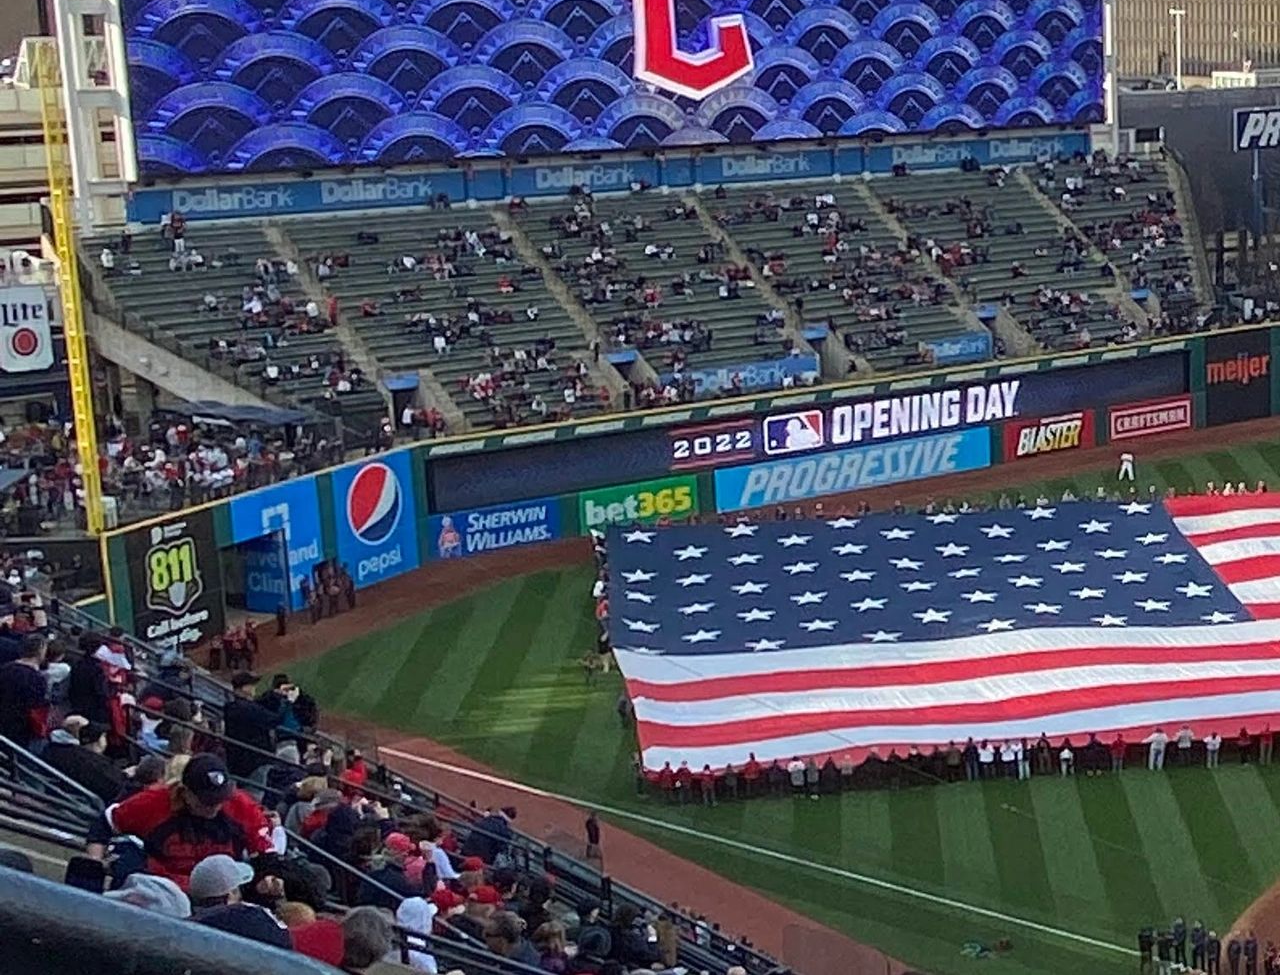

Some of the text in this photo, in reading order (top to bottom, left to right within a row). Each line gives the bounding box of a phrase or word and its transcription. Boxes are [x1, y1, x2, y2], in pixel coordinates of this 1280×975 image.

[1207, 352, 1271, 384] meijer
[673, 380, 1020, 459] 2022 OPENING DAY
[1016, 419, 1083, 457] BLASTER
[1116, 407, 1187, 432] CRAFTSMAN
[739, 434, 964, 506] PROGRESSIVE
[467, 505, 547, 533] SHERWIN
[585, 487, 691, 526] bet365
[465, 525, 550, 553] WILLIAMS
[150, 543, 193, 592] 811
[359, 545, 402, 581] pepsi
